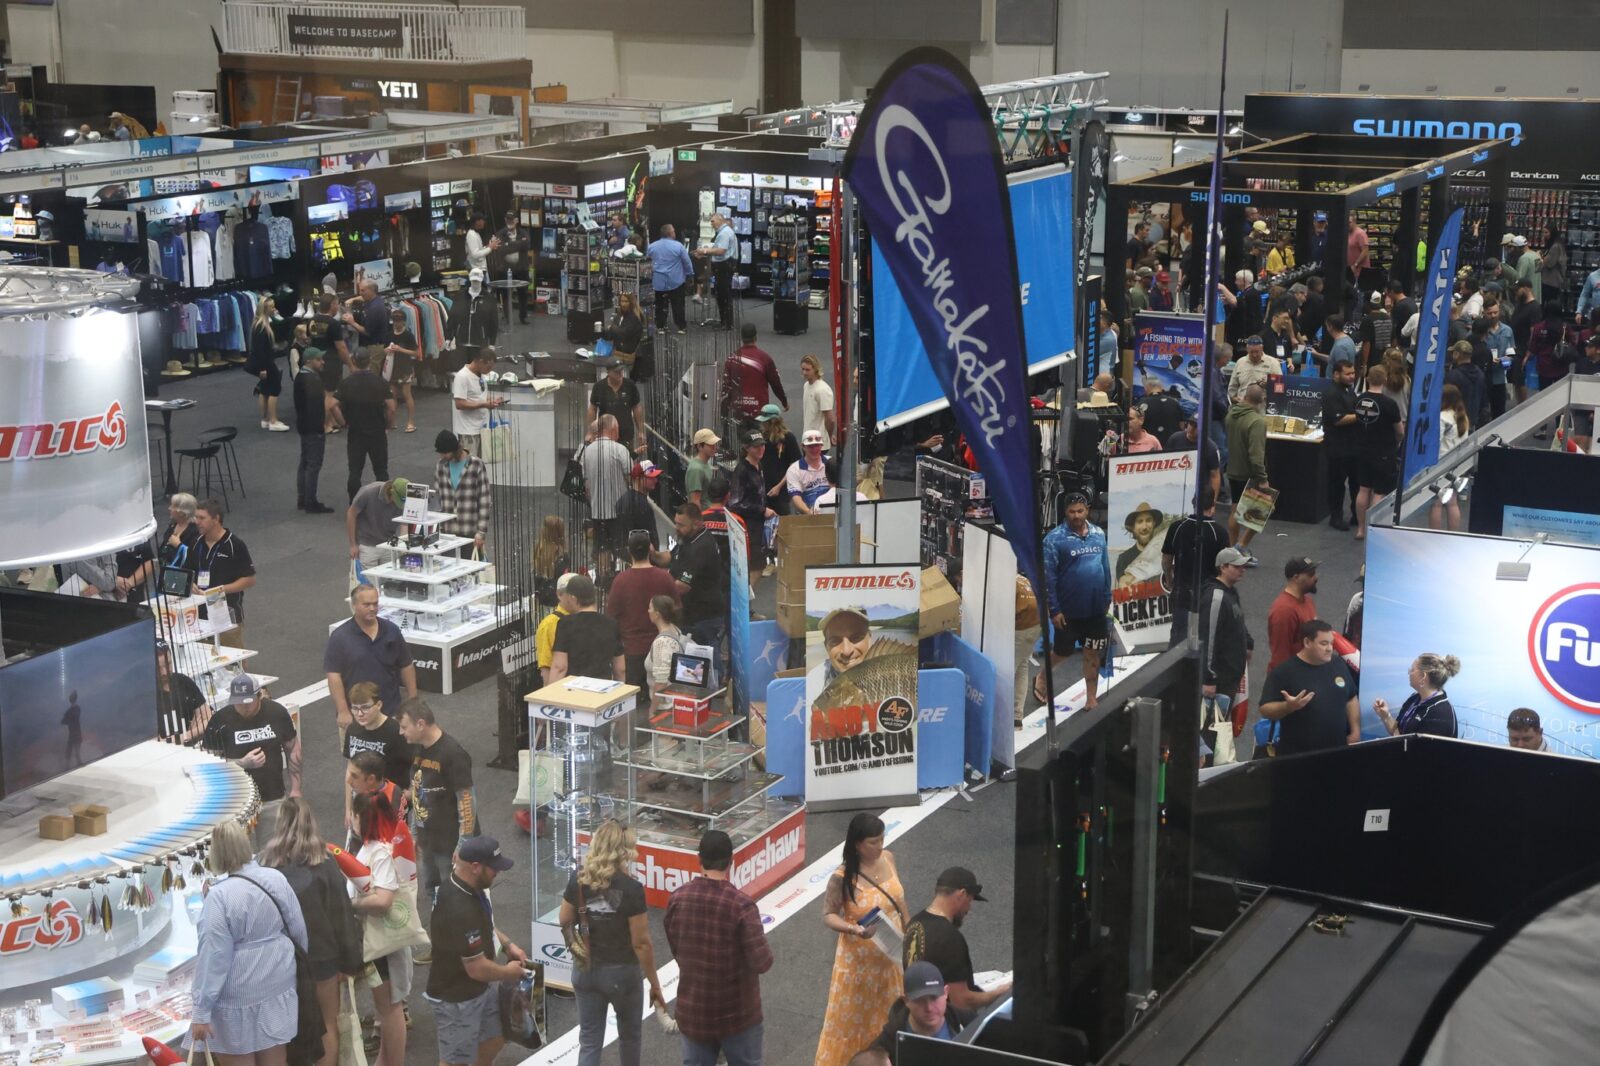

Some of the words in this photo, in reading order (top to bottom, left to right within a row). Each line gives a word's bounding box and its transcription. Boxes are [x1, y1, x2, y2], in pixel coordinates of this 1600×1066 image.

[295, 25, 335, 37] WELCOME
[337, 28, 348, 37] TO
[350, 28, 397, 38] BASECAMP
[377, 80, 418, 98] YETI
[1353, 118, 1522, 147] SHIMANO
[1510, 171, 1560, 180] Bantam
[263, 190, 281, 199] Huk
[1190, 191, 1252, 205] SHANO
[208, 199, 226, 208] Huk
[150, 205, 168, 216] Huk
[101, 219, 122, 230] Huk
[875, 104, 1006, 449] Gamakatsu
[1144, 333, 1149, 341] A
[1149, 334, 1173, 344] FISHING
[1173, 336, 1187, 344] TRIP
[1187, 337, 1203, 346] WITH
[1286, 389, 1322, 399] STRADIC
[1116, 458, 1180, 475] ATOMIC
[1540, 515, 1572, 524] CUSTOMERS
[814, 575, 899, 591] ATOMIC
[463, 646, 494, 665] Major
[810, 701, 881, 741] ANDY
[810, 727, 914, 766] THOMSON
[1370, 815, 1383, 824] T10
[729, 826, 801, 891] kershaw
